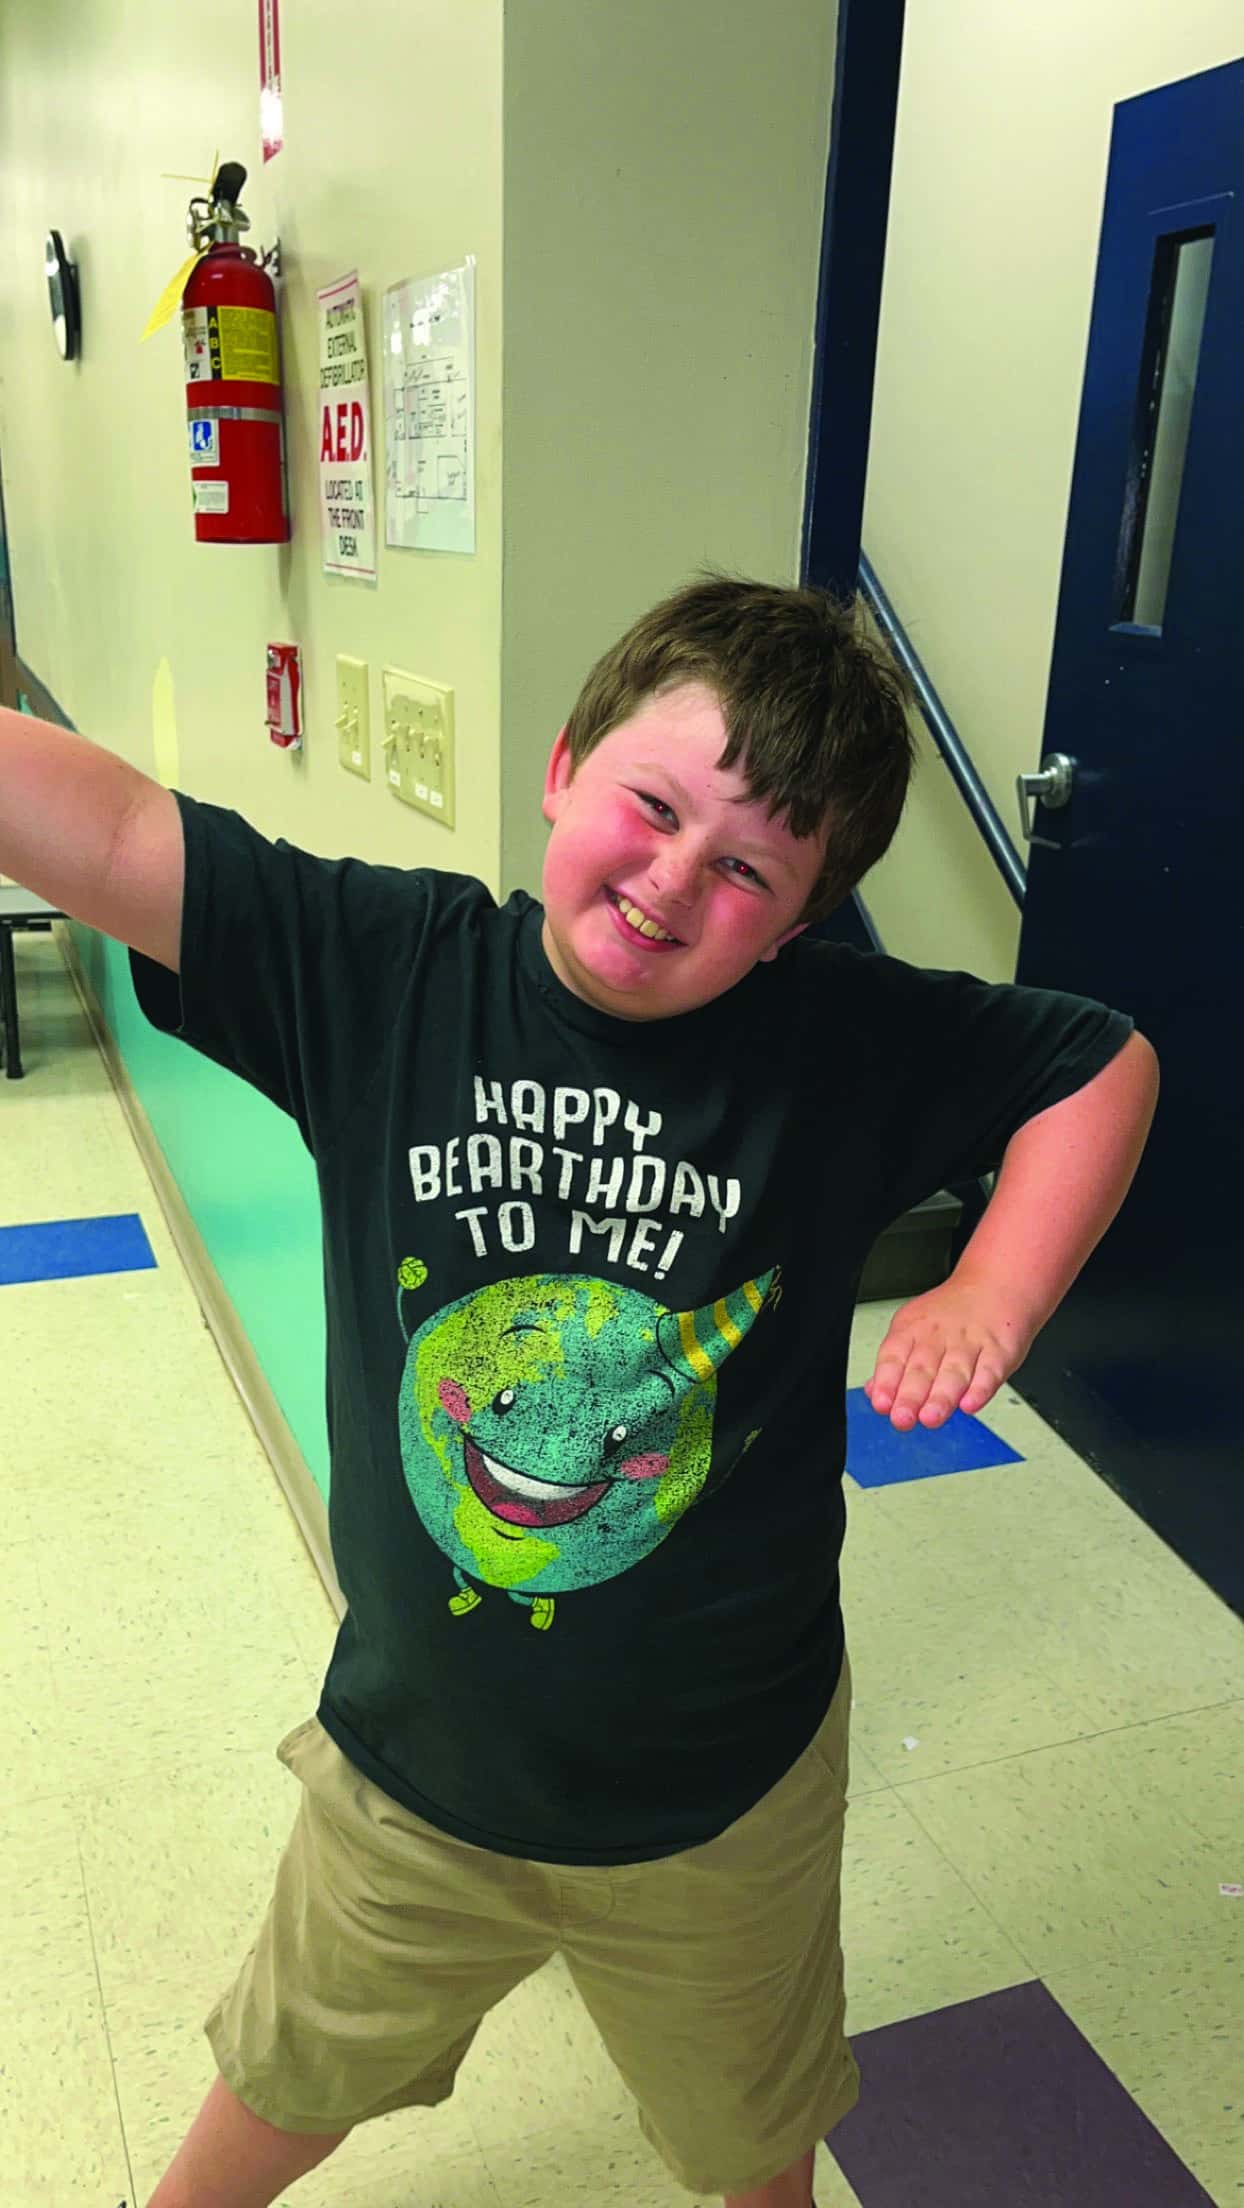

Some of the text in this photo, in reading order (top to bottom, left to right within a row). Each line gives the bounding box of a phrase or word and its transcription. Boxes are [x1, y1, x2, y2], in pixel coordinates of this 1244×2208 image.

[327, 331, 357, 358] EXTERNAL
[320, 359, 365, 388] DEFIBRILLATOR
[325, 480, 353, 500] LOCATED
[328, 507, 365, 530] THE FRONT
[473, 1075, 663, 1152] HAPPY
[408, 1133, 742, 1234] BEARTHDAY
[455, 1201, 685, 1280] TO ME!
